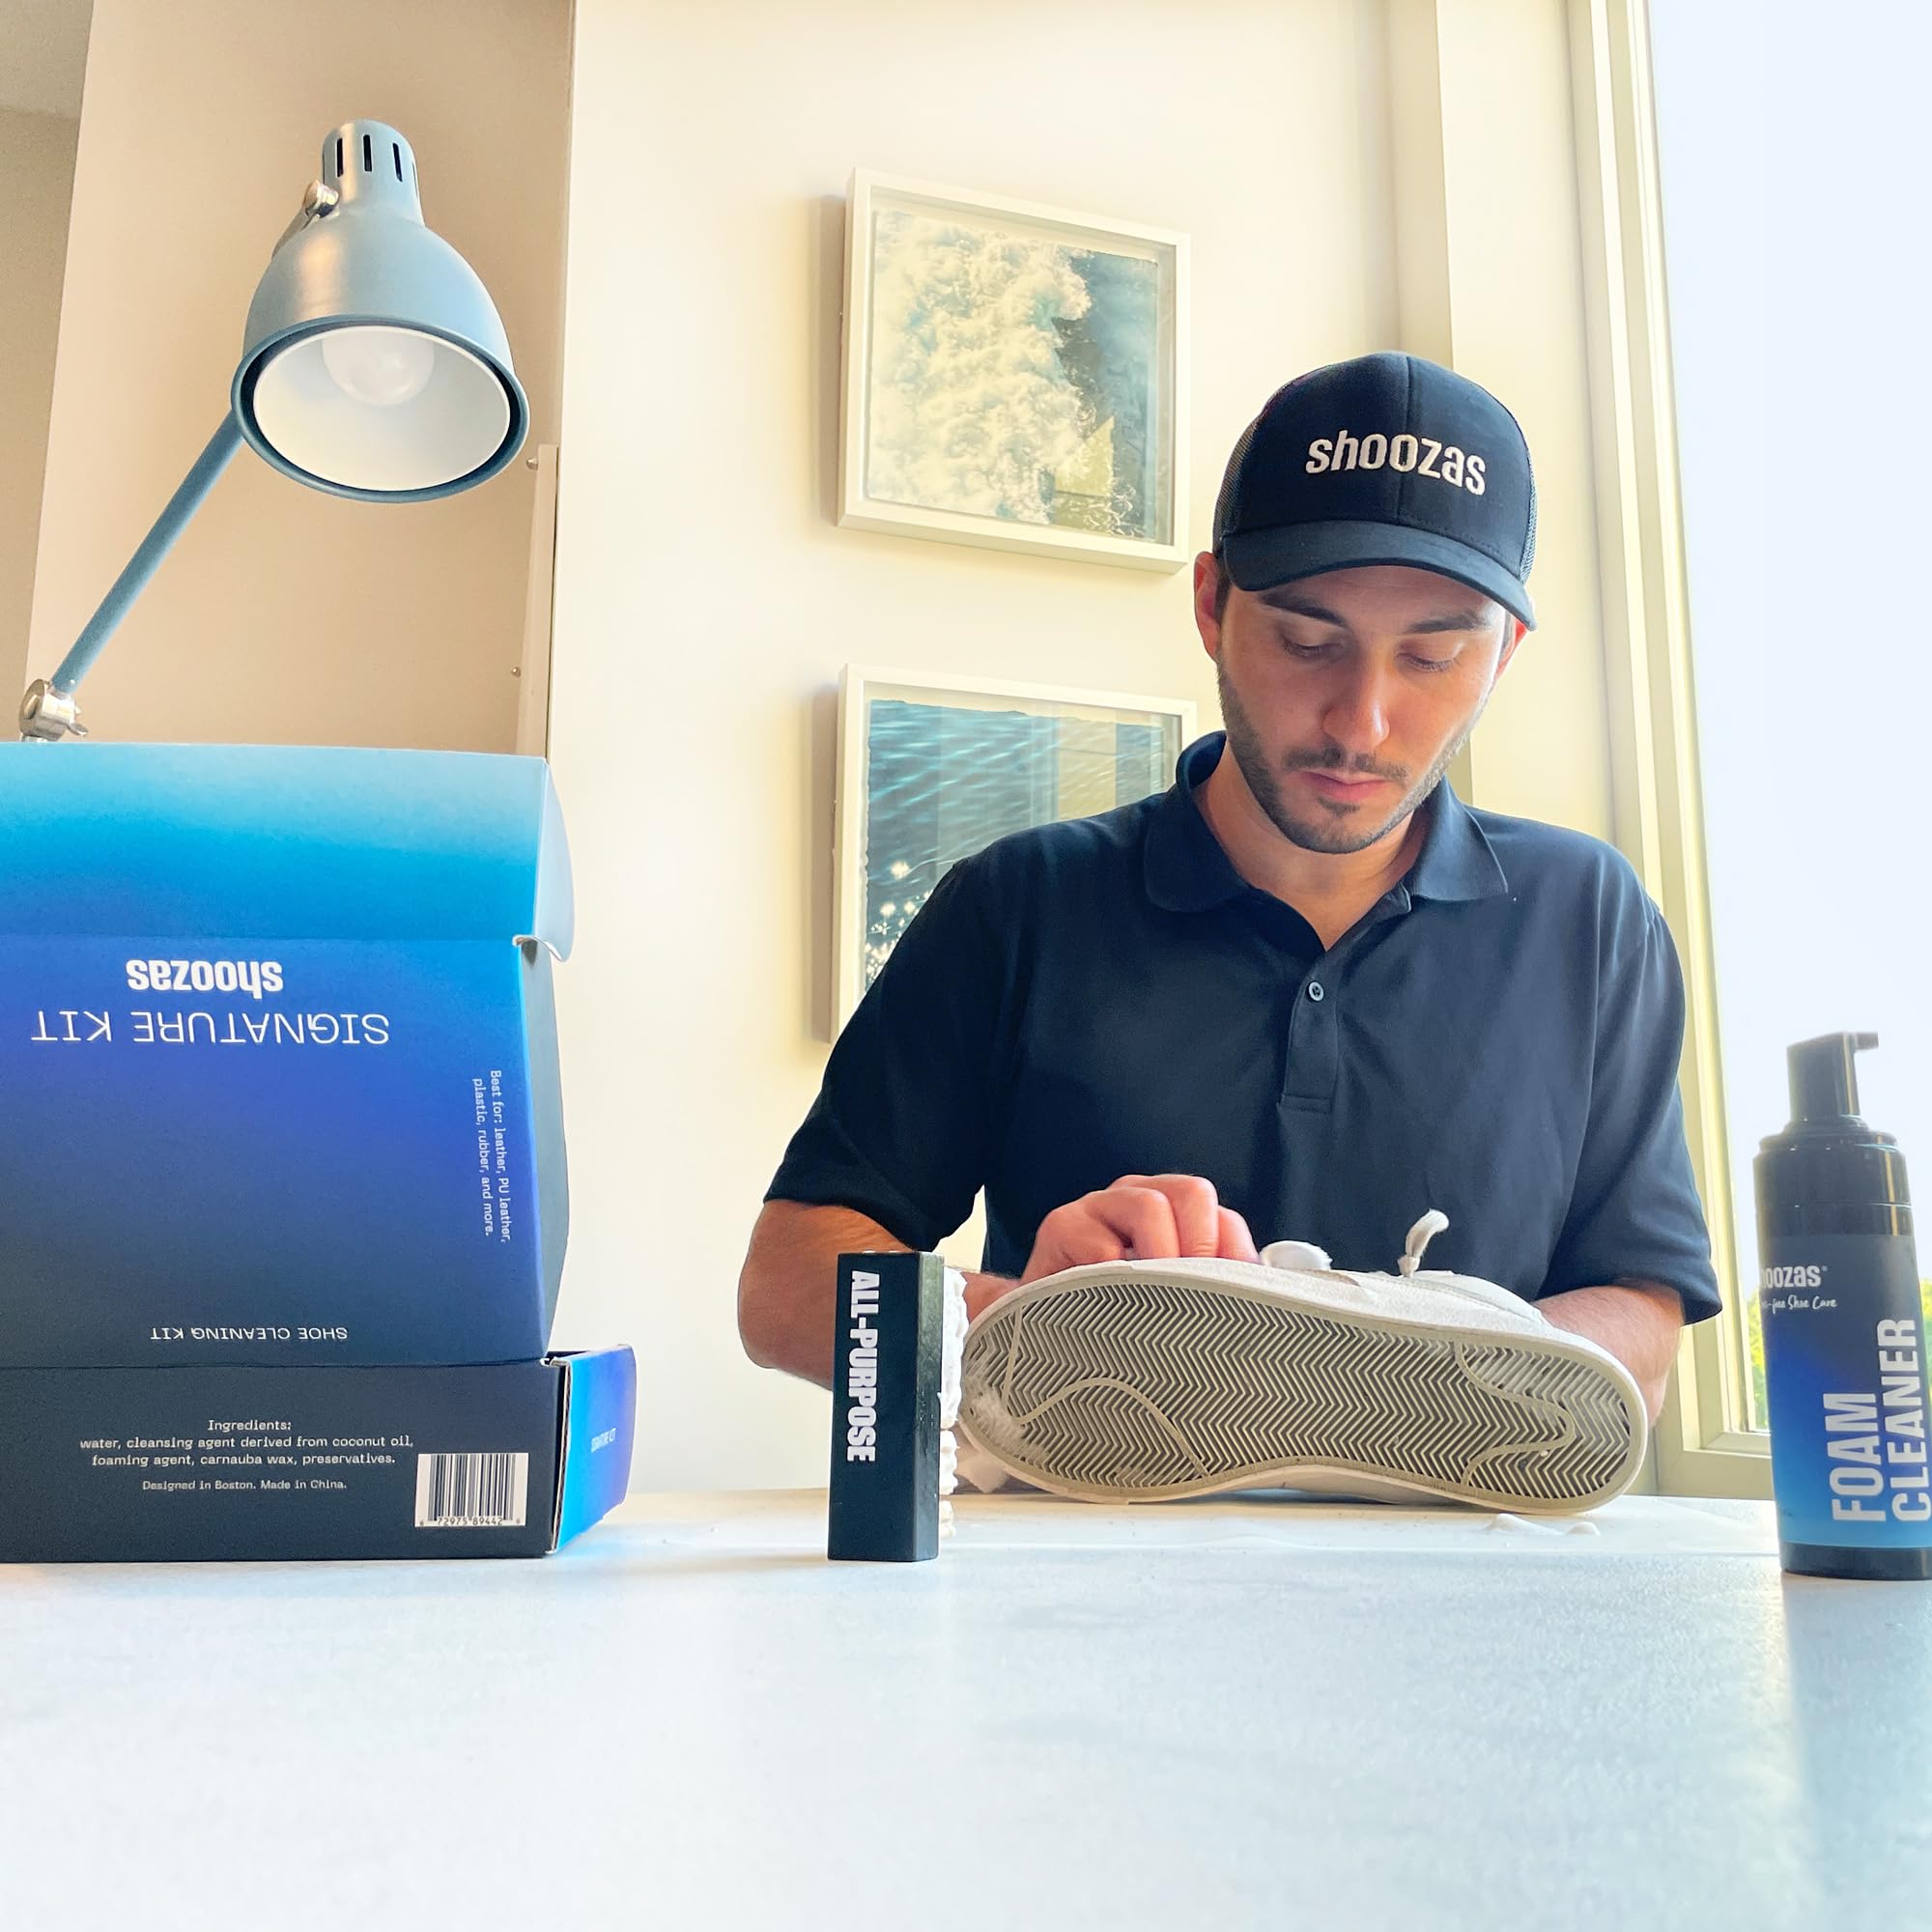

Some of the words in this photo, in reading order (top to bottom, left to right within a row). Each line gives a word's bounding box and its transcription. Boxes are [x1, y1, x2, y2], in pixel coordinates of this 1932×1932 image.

[1305, 430, 1487, 496] shoozas
[127, 959, 283, 999] shoozas
[31, 1010, 112, 1041] KIT
[130, 1011, 389, 1044] SIGNATURE
[491, 1070, 502, 1097] Best
[471, 1078, 488, 1125] plastic,
[493, 1101, 504, 1123] for:
[477, 1129, 491, 1173] rubber,
[495, 1127, 508, 1174] leather,
[481, 1177, 494, 1199] and
[498, 1178, 510, 1194] PU
[483, 1203, 494, 1236] more.
[499, 1198, 513, 1243] leather,
[1787, 1294, 1809, 1310] Shoe
[1812, 1296, 1837, 1309] Care
[150, 1327, 185, 1340] KIT
[190, 1327, 291, 1340] CLEANING
[298, 1327, 348, 1340] SHOE
[846, 1270, 880, 1462] ALL-PURPOSE
[207, 1419, 292, 1433] Ingredients:
[1876, 1319, 1932, 1521] CLEANER
[79, 1438, 122, 1450] water,
[127, 1436, 193, 1450] cleansing
[198, 1437, 236, 1450] agent
[241, 1435, 292, 1448] derived
[296, 1435, 327, 1447] from
[331, 1436, 385, 1447] coconut
[390, 1435, 413, 1448] oil,
[1823, 1393, 1886, 1521] FOAM
[92, 1454, 149, 1467] foaming
[153, 1455, 195, 1467] agent,
[200, 1453, 263, 1465] carnauba
[267, 1455, 298, 1466] wax,
[302, 1452, 396, 1466] preservatives.
[142, 1480, 195, 1492] Designed
[199, 1479, 212, 1490] in
[214, 1479, 257, 1491] Boston.
[260, 1479, 291, 1490] Made
[295, 1479, 307, 1489] in
[310, 1478, 347, 1490] China.
